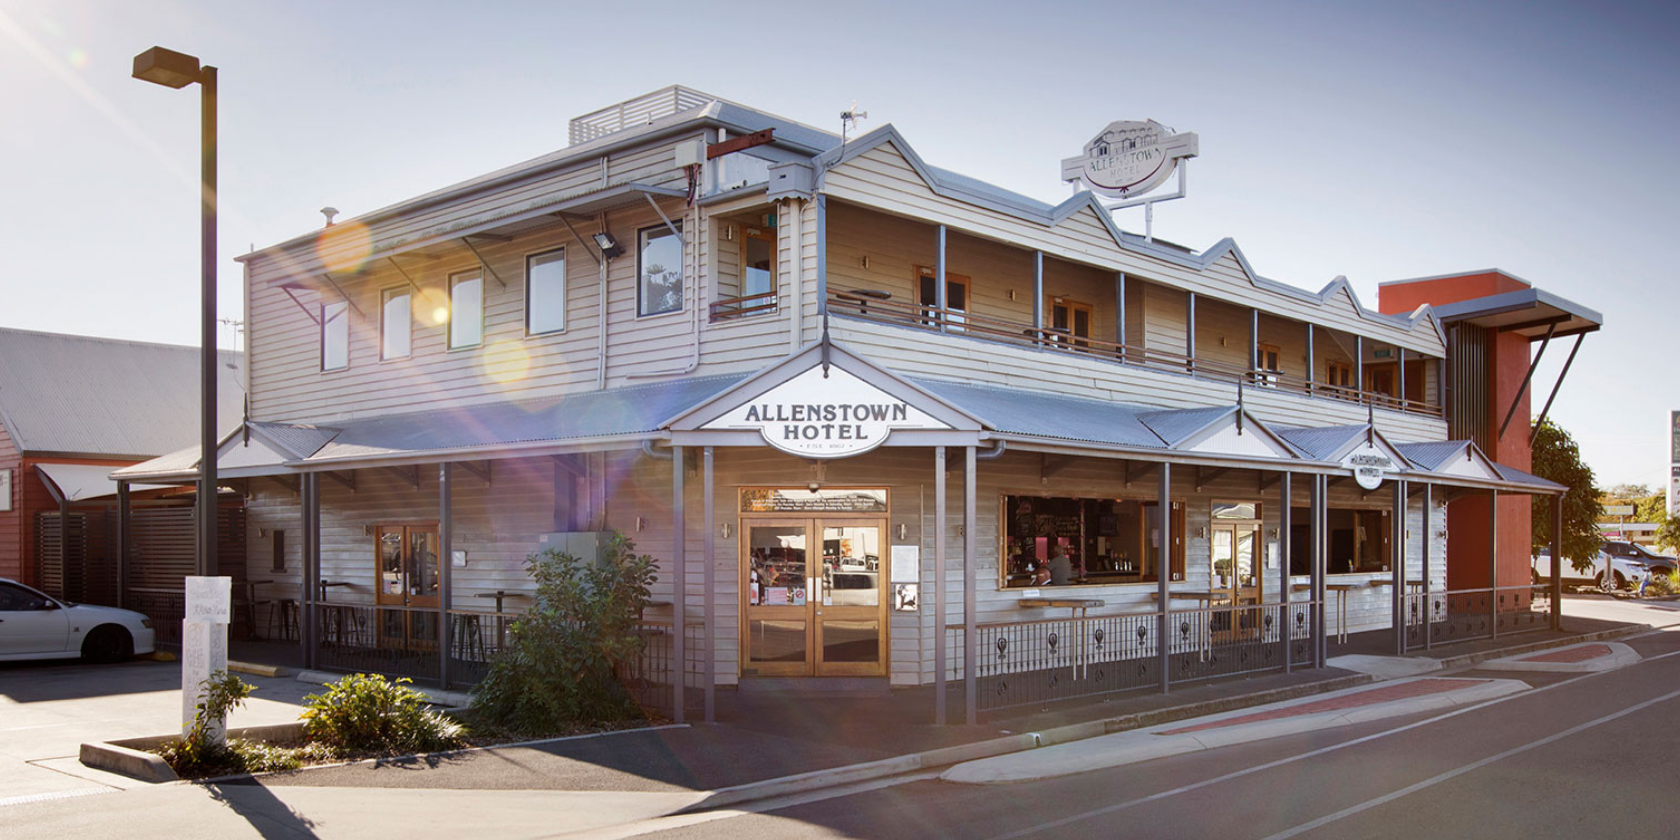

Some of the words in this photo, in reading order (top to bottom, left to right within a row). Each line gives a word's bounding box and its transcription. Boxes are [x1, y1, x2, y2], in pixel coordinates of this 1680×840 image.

[1090, 148, 1161, 171] ALLENSTOWN
[1110, 165, 1141, 178] HOTEL
[745, 403, 907, 421] ALLENSTOWN
[783, 424, 868, 440] HOTEL
